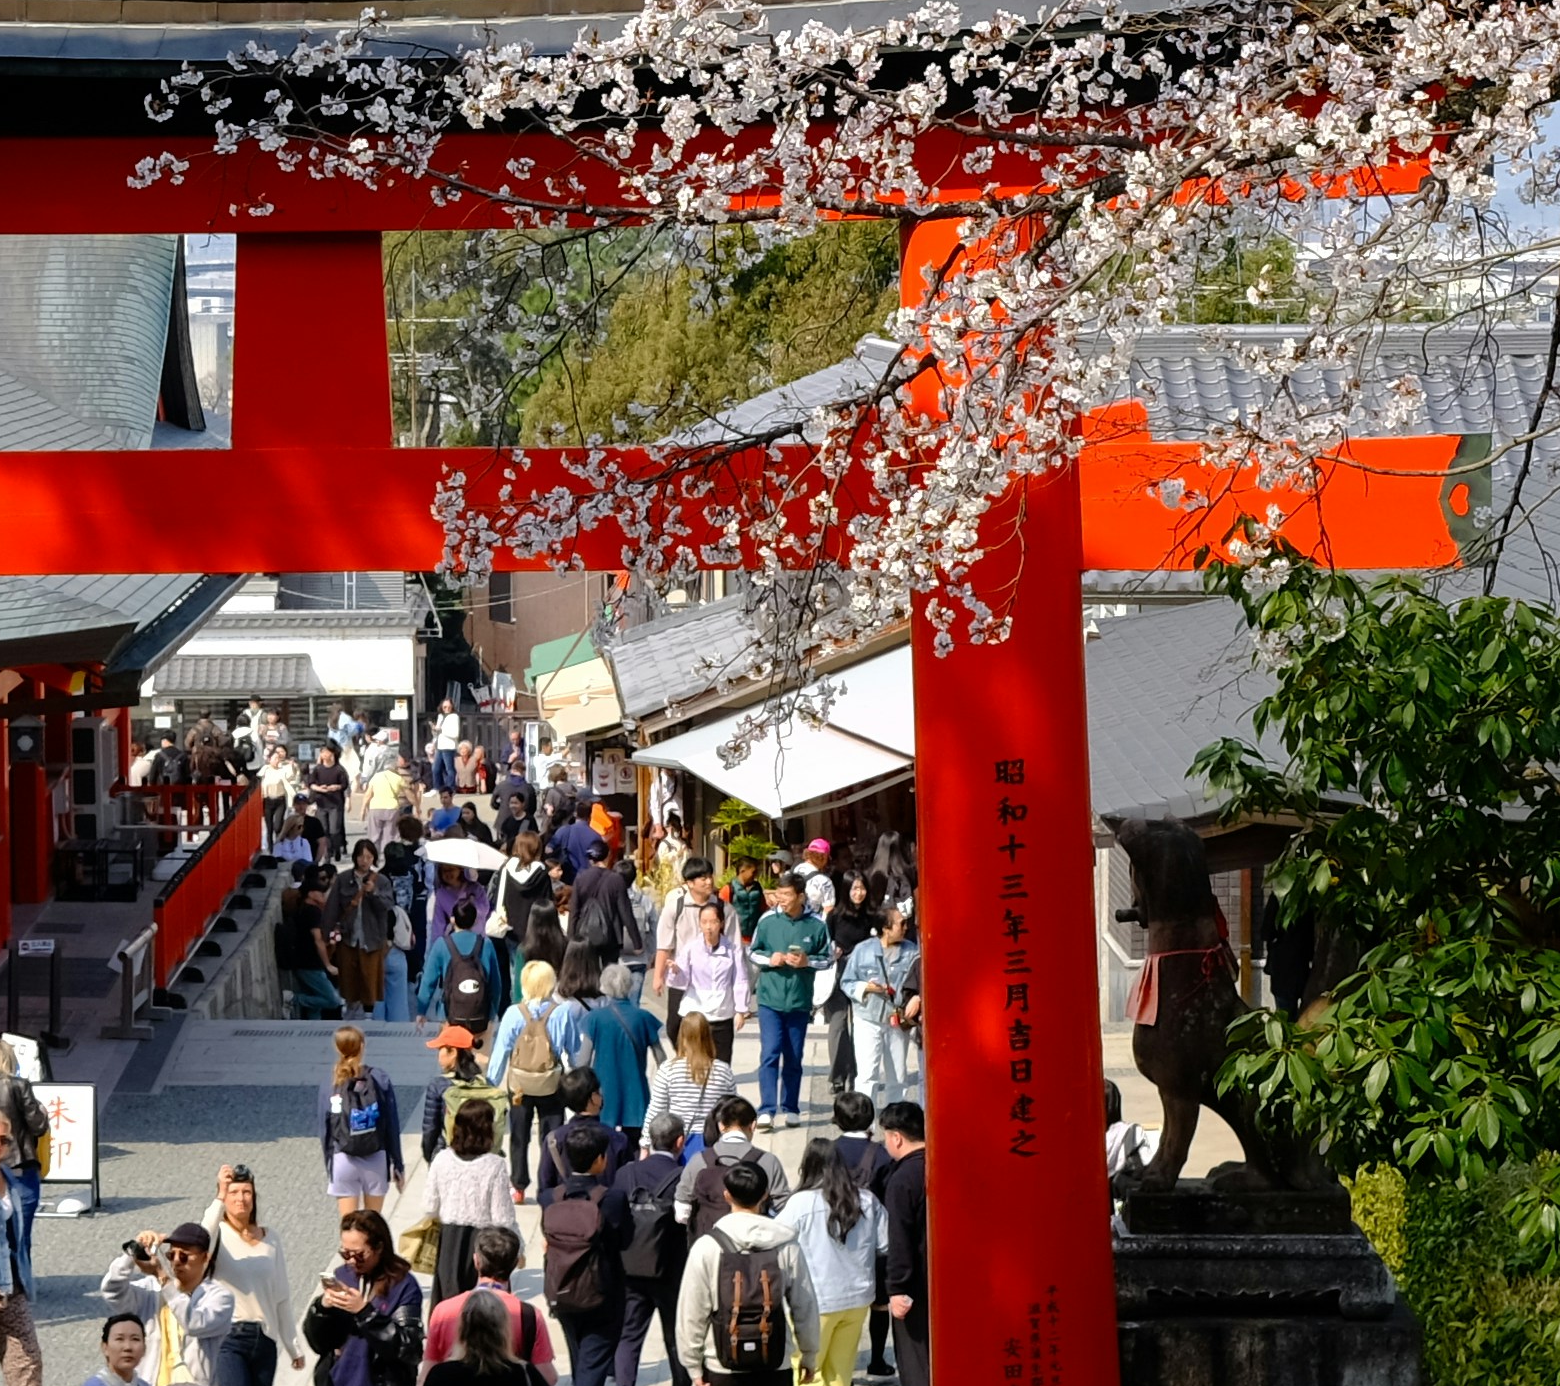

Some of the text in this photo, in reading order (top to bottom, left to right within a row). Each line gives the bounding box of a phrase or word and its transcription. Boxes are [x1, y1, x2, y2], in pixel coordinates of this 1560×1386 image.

[994, 758, 1041, 1158] 昭和十三年三月吉日建之
